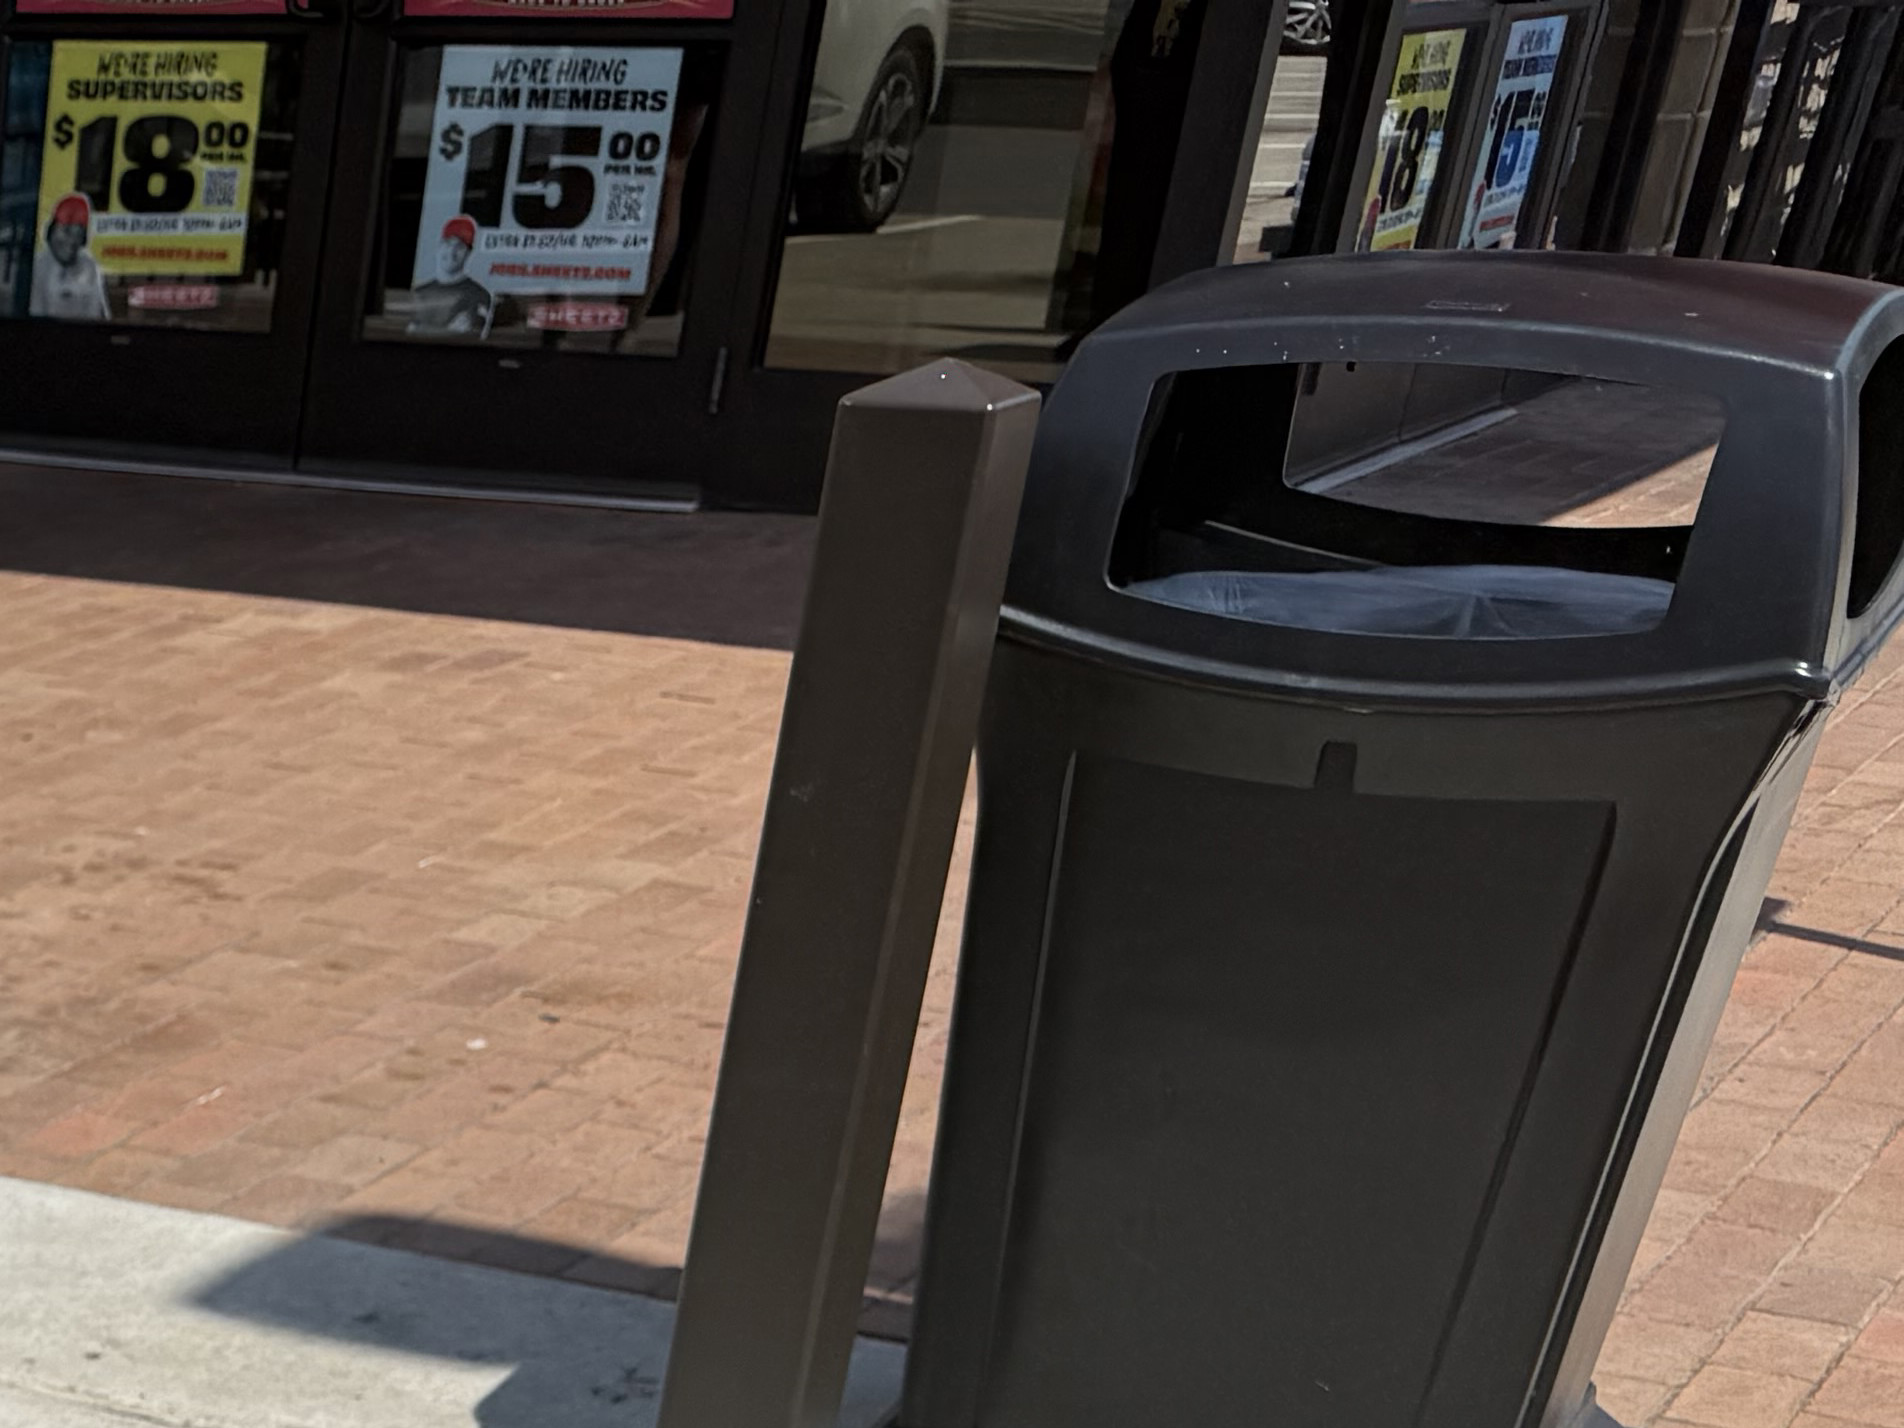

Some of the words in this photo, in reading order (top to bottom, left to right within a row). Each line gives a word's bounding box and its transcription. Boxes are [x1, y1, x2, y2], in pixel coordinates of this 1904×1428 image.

[96, 53, 151, 77] WE'RE
[154, 52, 218, 78] HIRING
[492, 57, 553, 84] WE'RE
[556, 59, 628, 85] HIRING
[66, 79, 244, 101] SUPERVISORS
[444, 85, 520, 109] TEAM
[524, 88, 668, 112] MEMBERS
[52, 113, 199, 214] $18
[204, 121, 250, 149] 00
[438, 122, 603, 229] $15
[607, 131, 661, 161] 00
